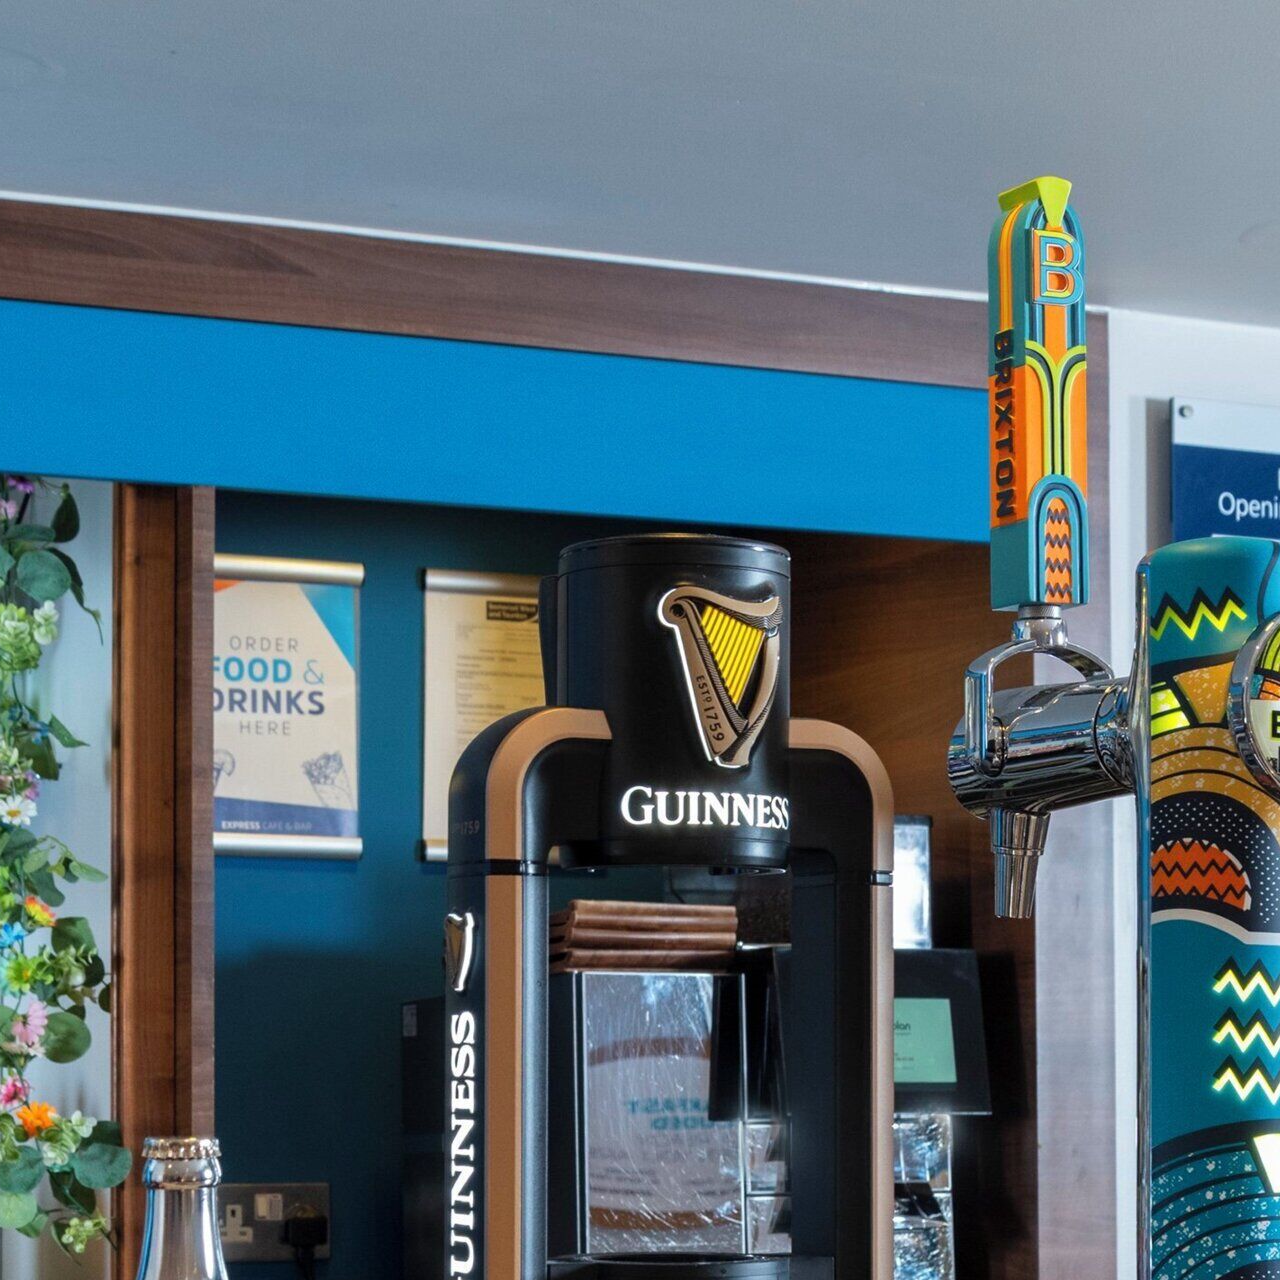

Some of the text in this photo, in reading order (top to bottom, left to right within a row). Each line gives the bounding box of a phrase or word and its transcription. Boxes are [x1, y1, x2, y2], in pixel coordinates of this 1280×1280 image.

[1032, 228, 1083, 306] B
[993, 329, 1017, 519] BRIXTON
[229, 635, 299, 651] ORDER
[303, 660, 325, 685] &
[239, 720, 292, 736] HERE
[704, 705, 725, 742] 1759
[621, 785, 789, 831] GUINNESS
[221, 820, 261, 831] EXPRESS
